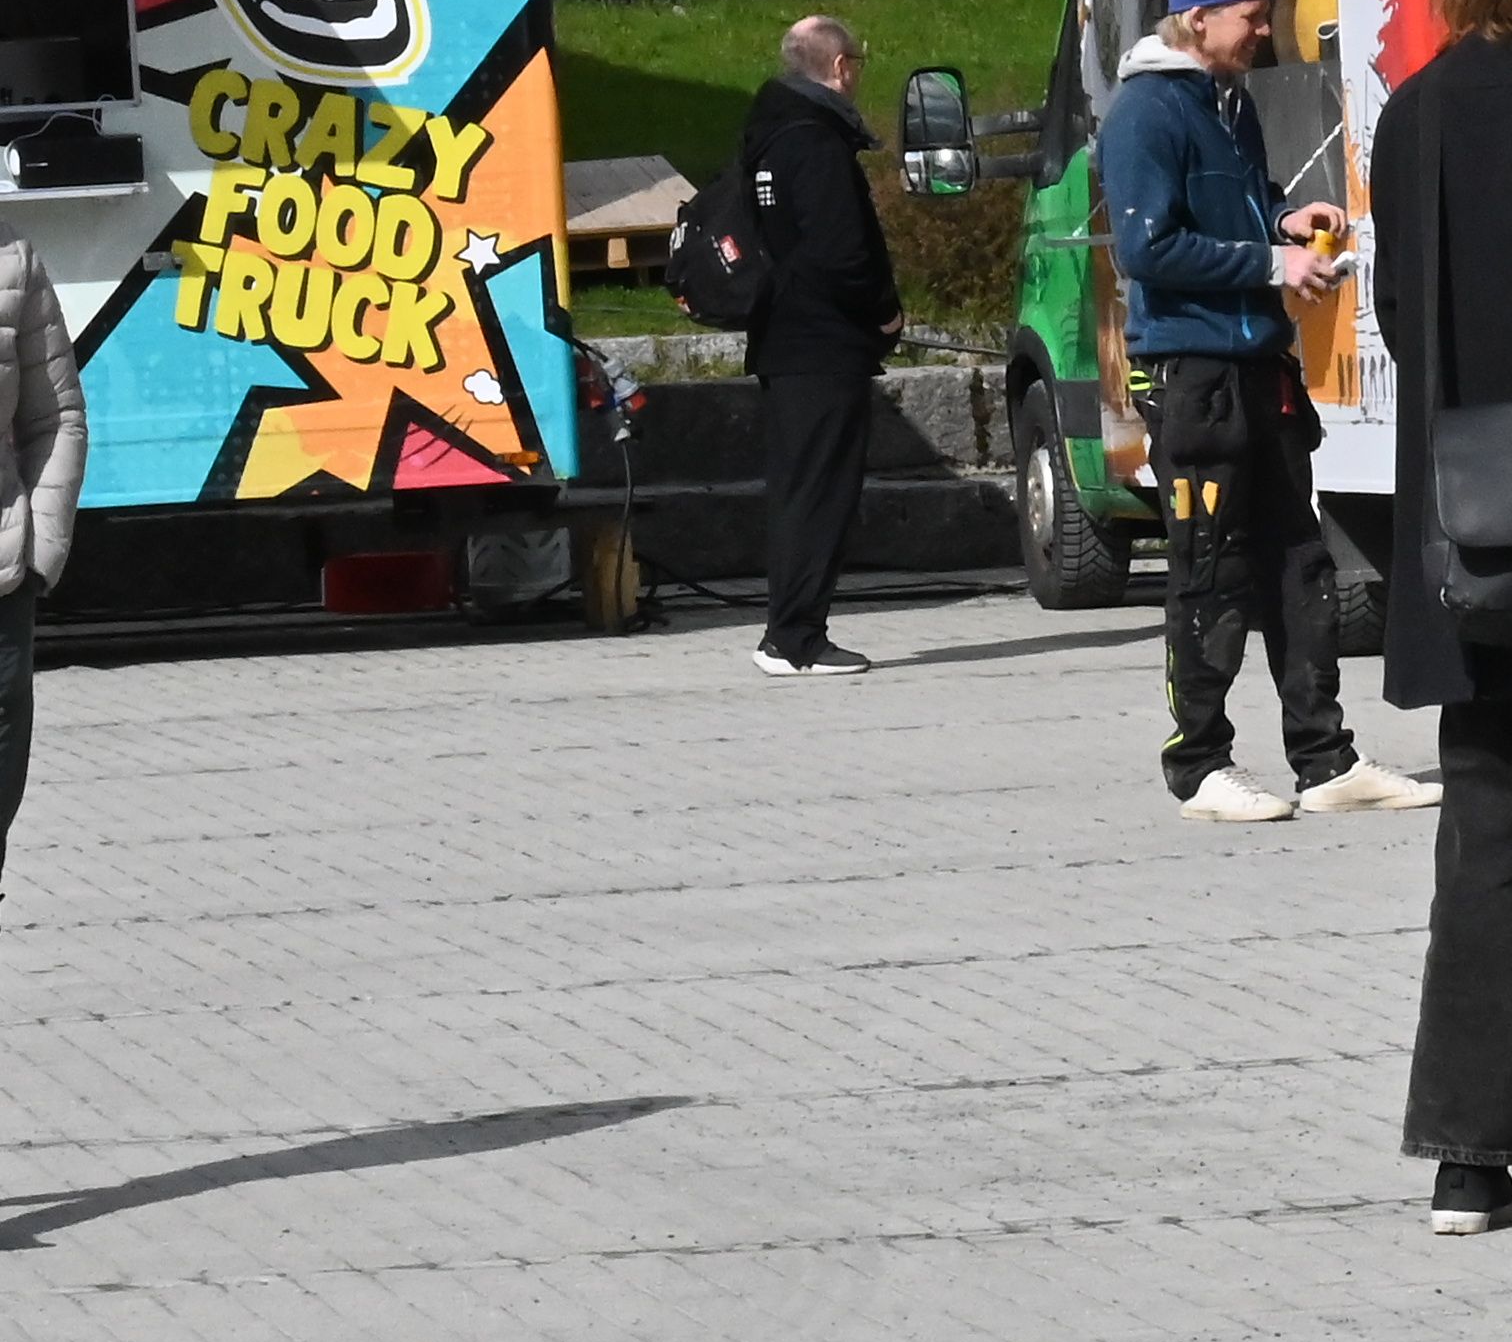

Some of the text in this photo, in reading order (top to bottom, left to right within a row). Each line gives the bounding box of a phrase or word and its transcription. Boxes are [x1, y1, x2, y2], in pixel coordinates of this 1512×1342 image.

[188, 67, 492, 202] CRAZY
[200, 161, 444, 286] FOOD
[171, 239, 454, 372] TRUCK
